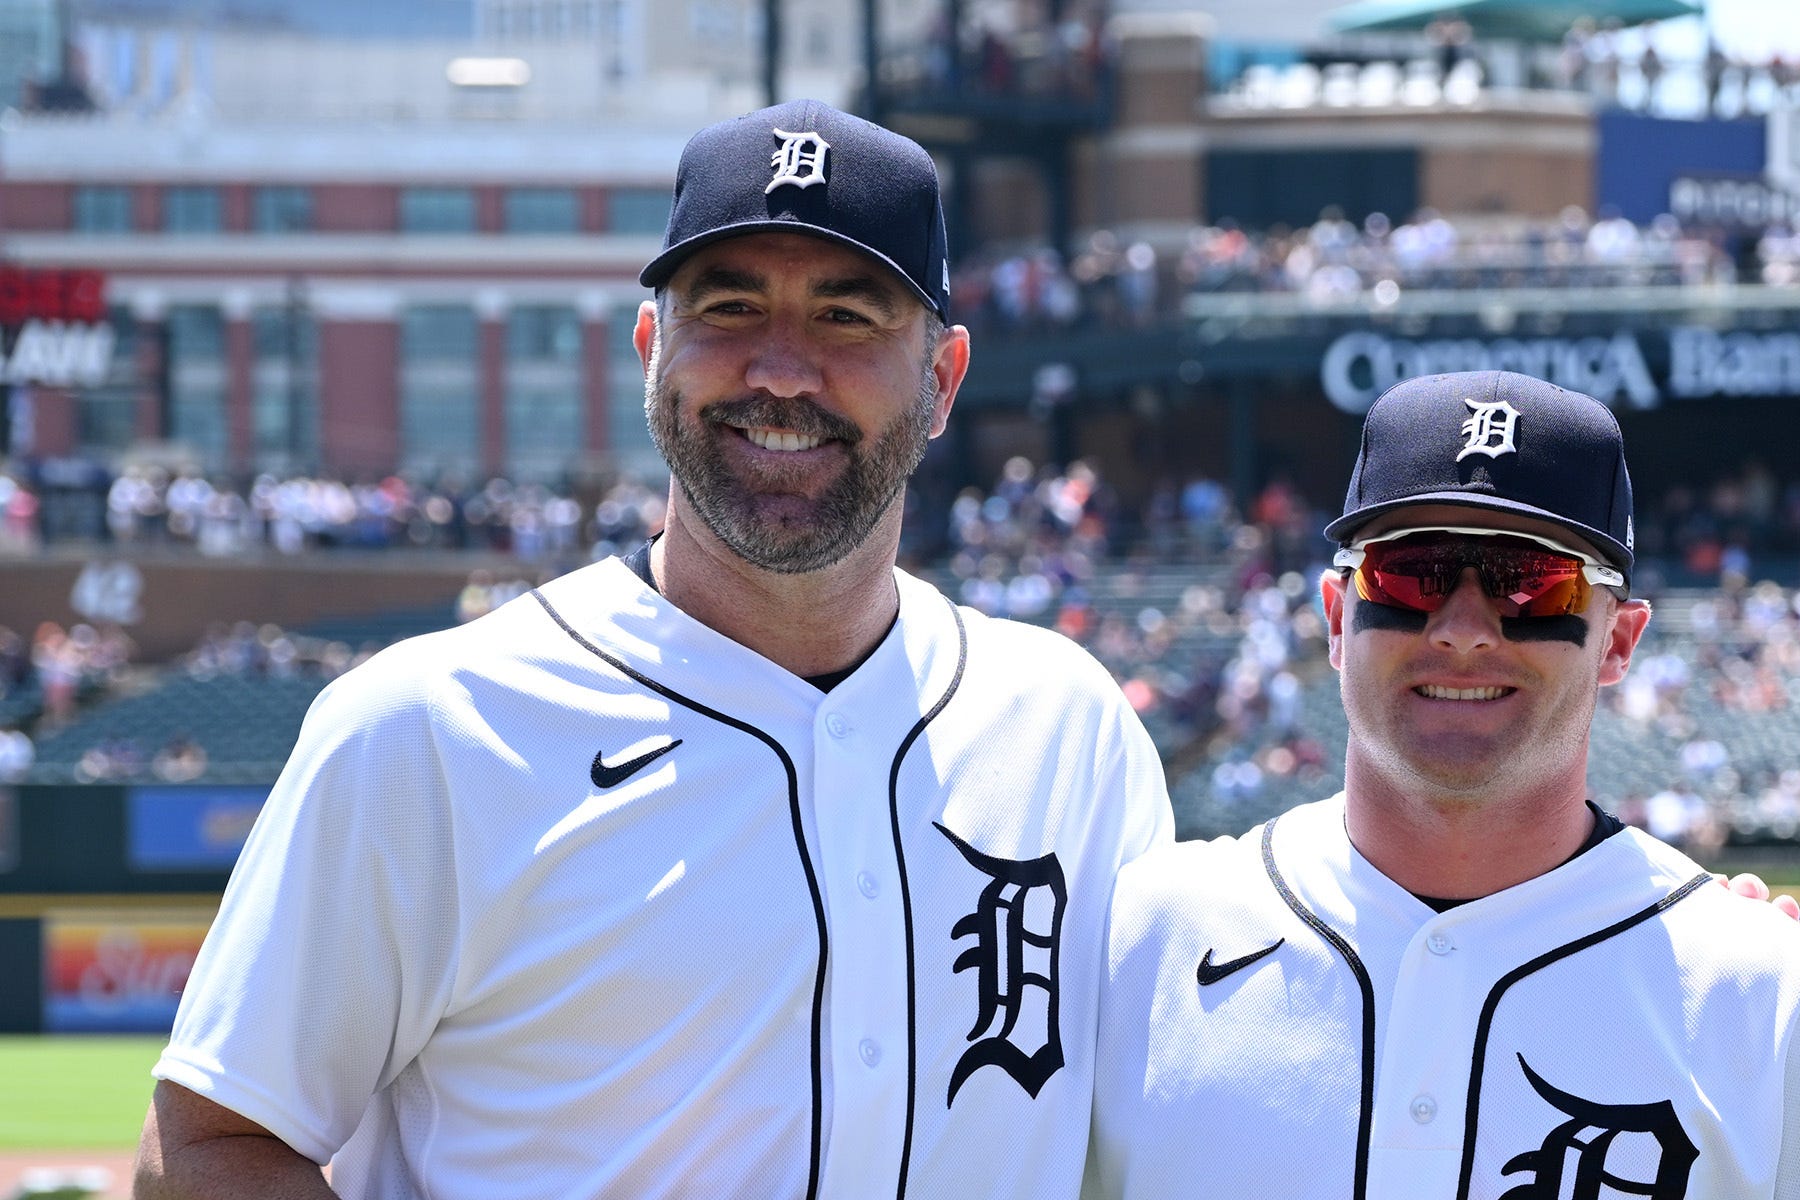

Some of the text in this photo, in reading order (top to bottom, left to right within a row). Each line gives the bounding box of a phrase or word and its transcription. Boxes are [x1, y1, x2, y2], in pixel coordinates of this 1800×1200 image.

[765, 128, 831, 194] D
[1456, 398, 1521, 462] D
[932, 821, 1067, 1109] D
